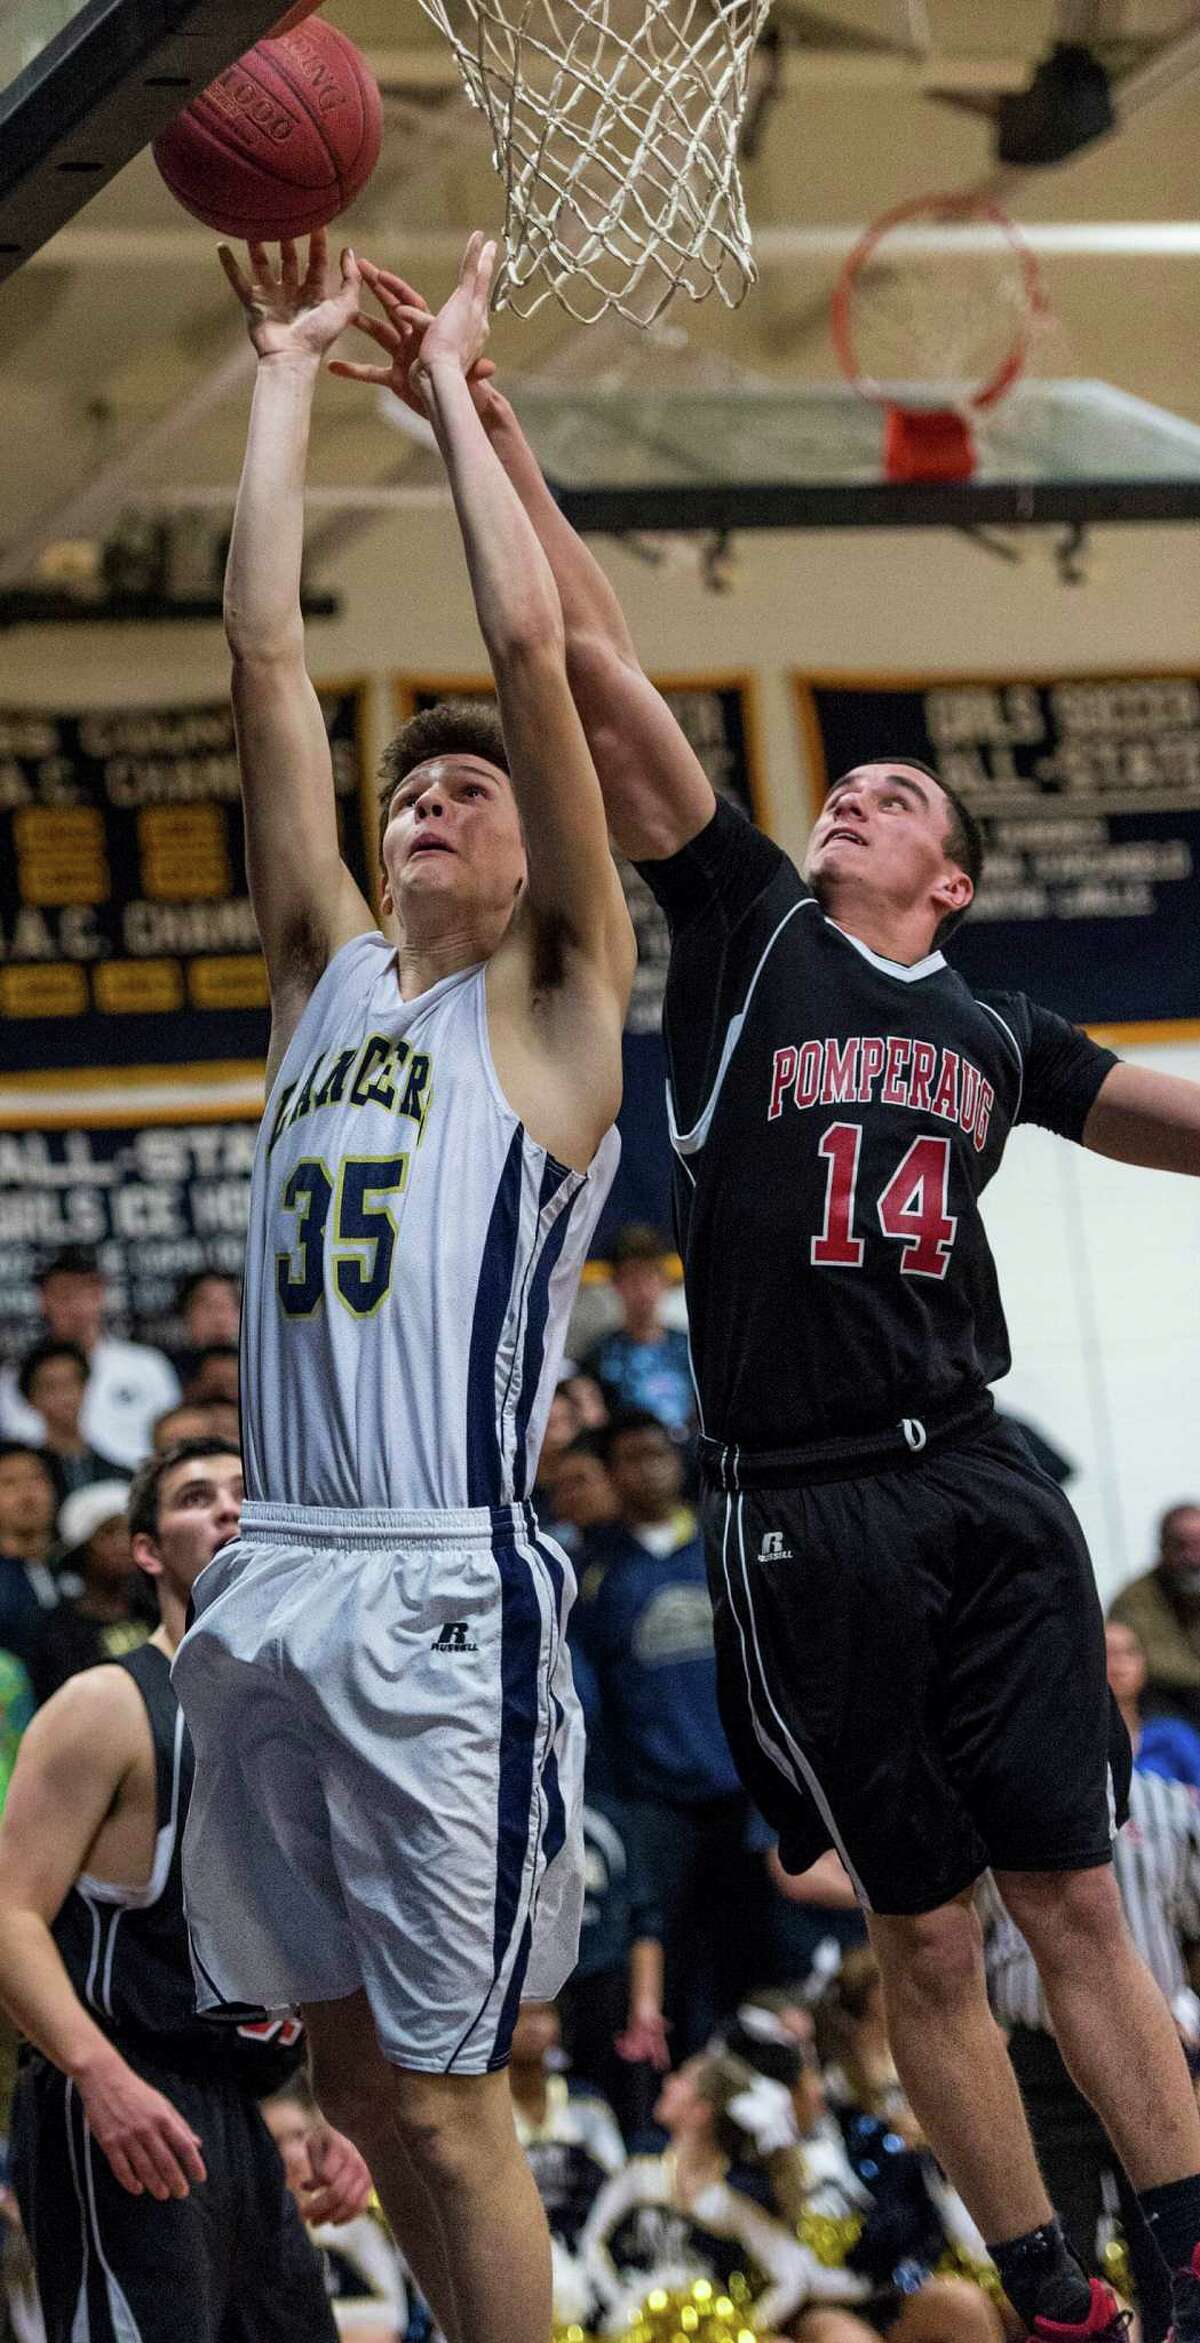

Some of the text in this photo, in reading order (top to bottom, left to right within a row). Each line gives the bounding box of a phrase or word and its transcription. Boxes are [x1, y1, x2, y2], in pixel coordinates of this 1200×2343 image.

[266, 1031, 434, 1157] LANCER
[767, 1036, 995, 1152] POMPERAUG
[275, 1152, 410, 1321] 35
[810, 1121, 958, 1281] 14
[430, 1642, 479, 1653] RUSSELL
